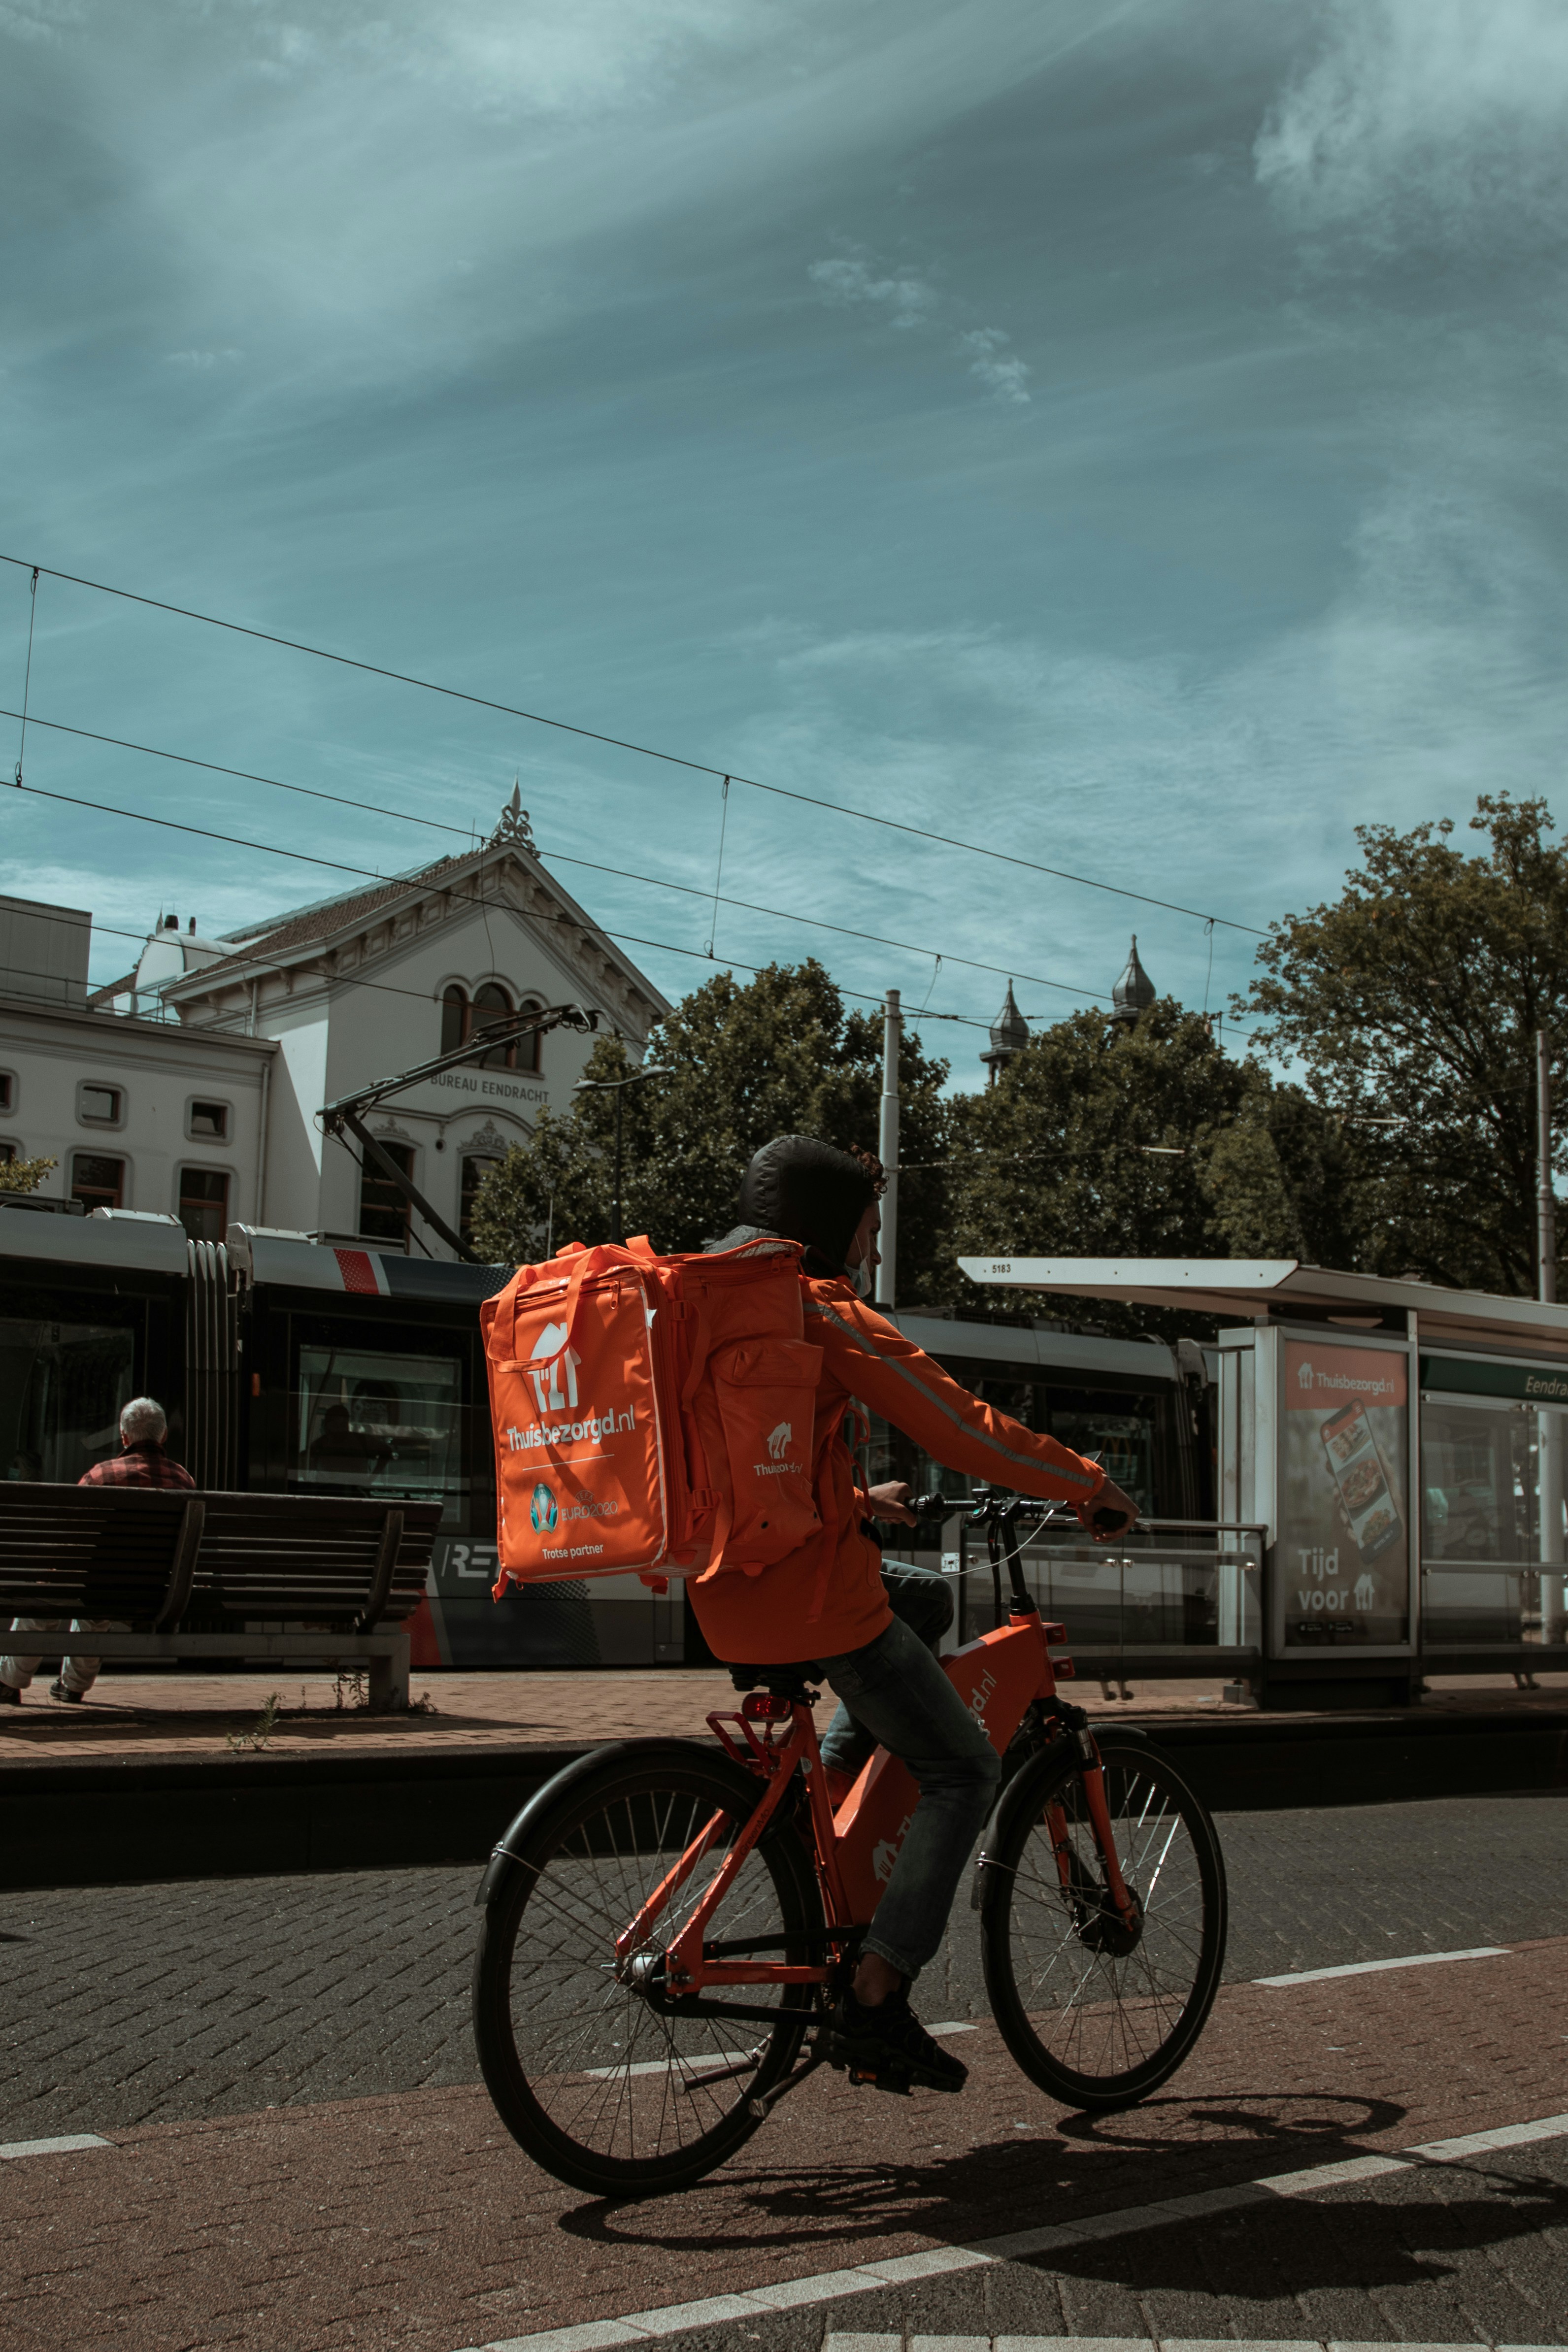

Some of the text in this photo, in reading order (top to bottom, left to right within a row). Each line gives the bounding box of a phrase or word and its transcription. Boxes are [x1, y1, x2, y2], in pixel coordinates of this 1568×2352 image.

[431, 1073, 549, 1103] BUREAU EENDRACHT
[993, 1264, 1011, 1273] 5183
[1316, 1372, 1395, 1395] Thuisbezorgd.nl
[1526, 1375, 1568, 1396] Eendra
[507, 1404, 635, 1451] Thuisbezorgd.nl
[575, 1491, 595, 1503] UEFA
[451, 1544, 500, 1578] RE
[542, 1544, 603, 1559] Trotse partner
[1298, 1547, 1339, 1582] Tijd
[1298, 1590, 1349, 1611] voor
